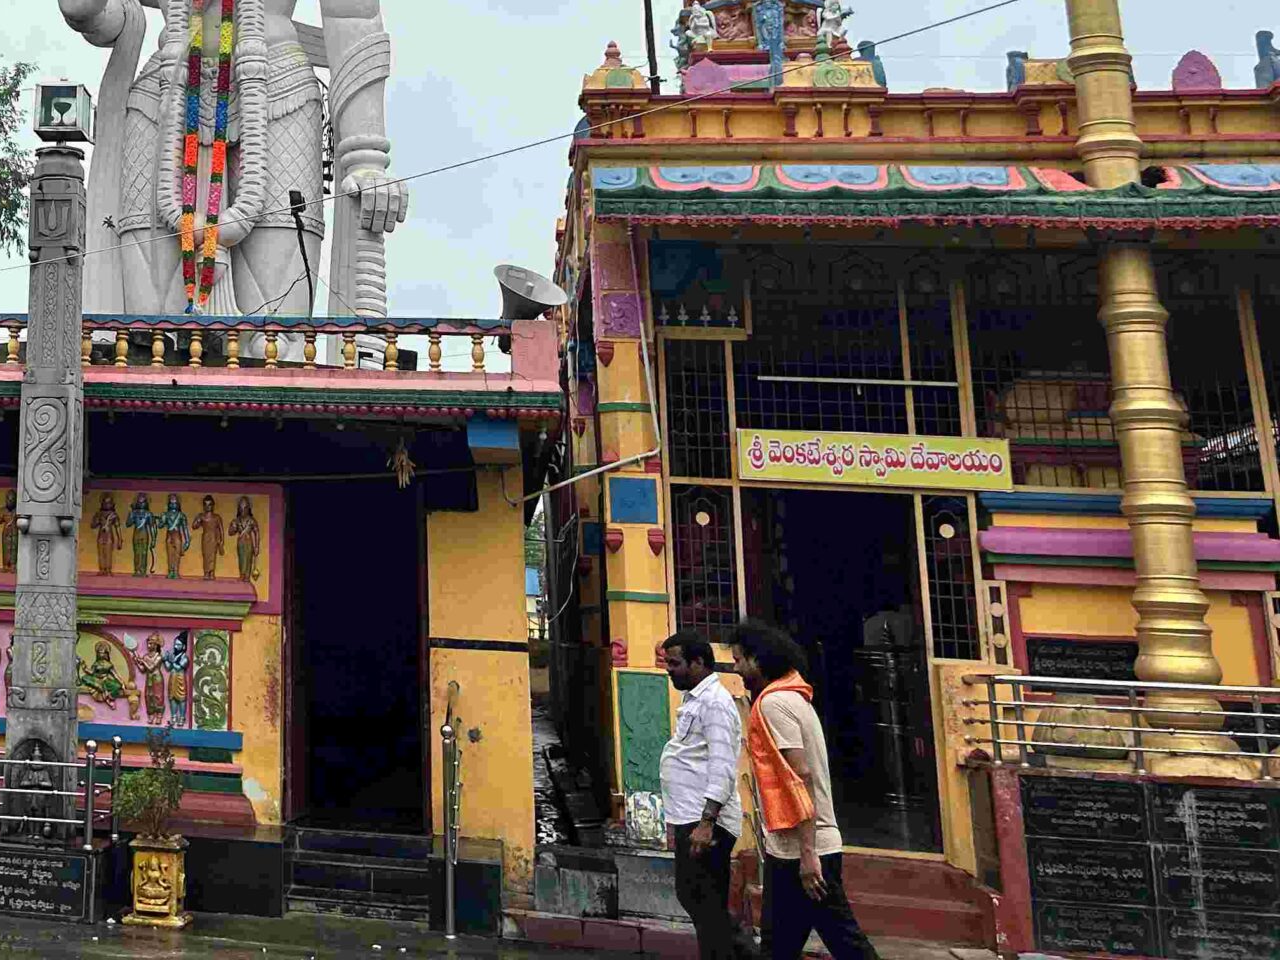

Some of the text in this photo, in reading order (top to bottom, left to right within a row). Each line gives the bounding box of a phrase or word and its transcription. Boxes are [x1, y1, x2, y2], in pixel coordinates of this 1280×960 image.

[748, 434, 1003, 477] శ్రీ వెంకటేశ్వర స్వామి దేవాలయం
